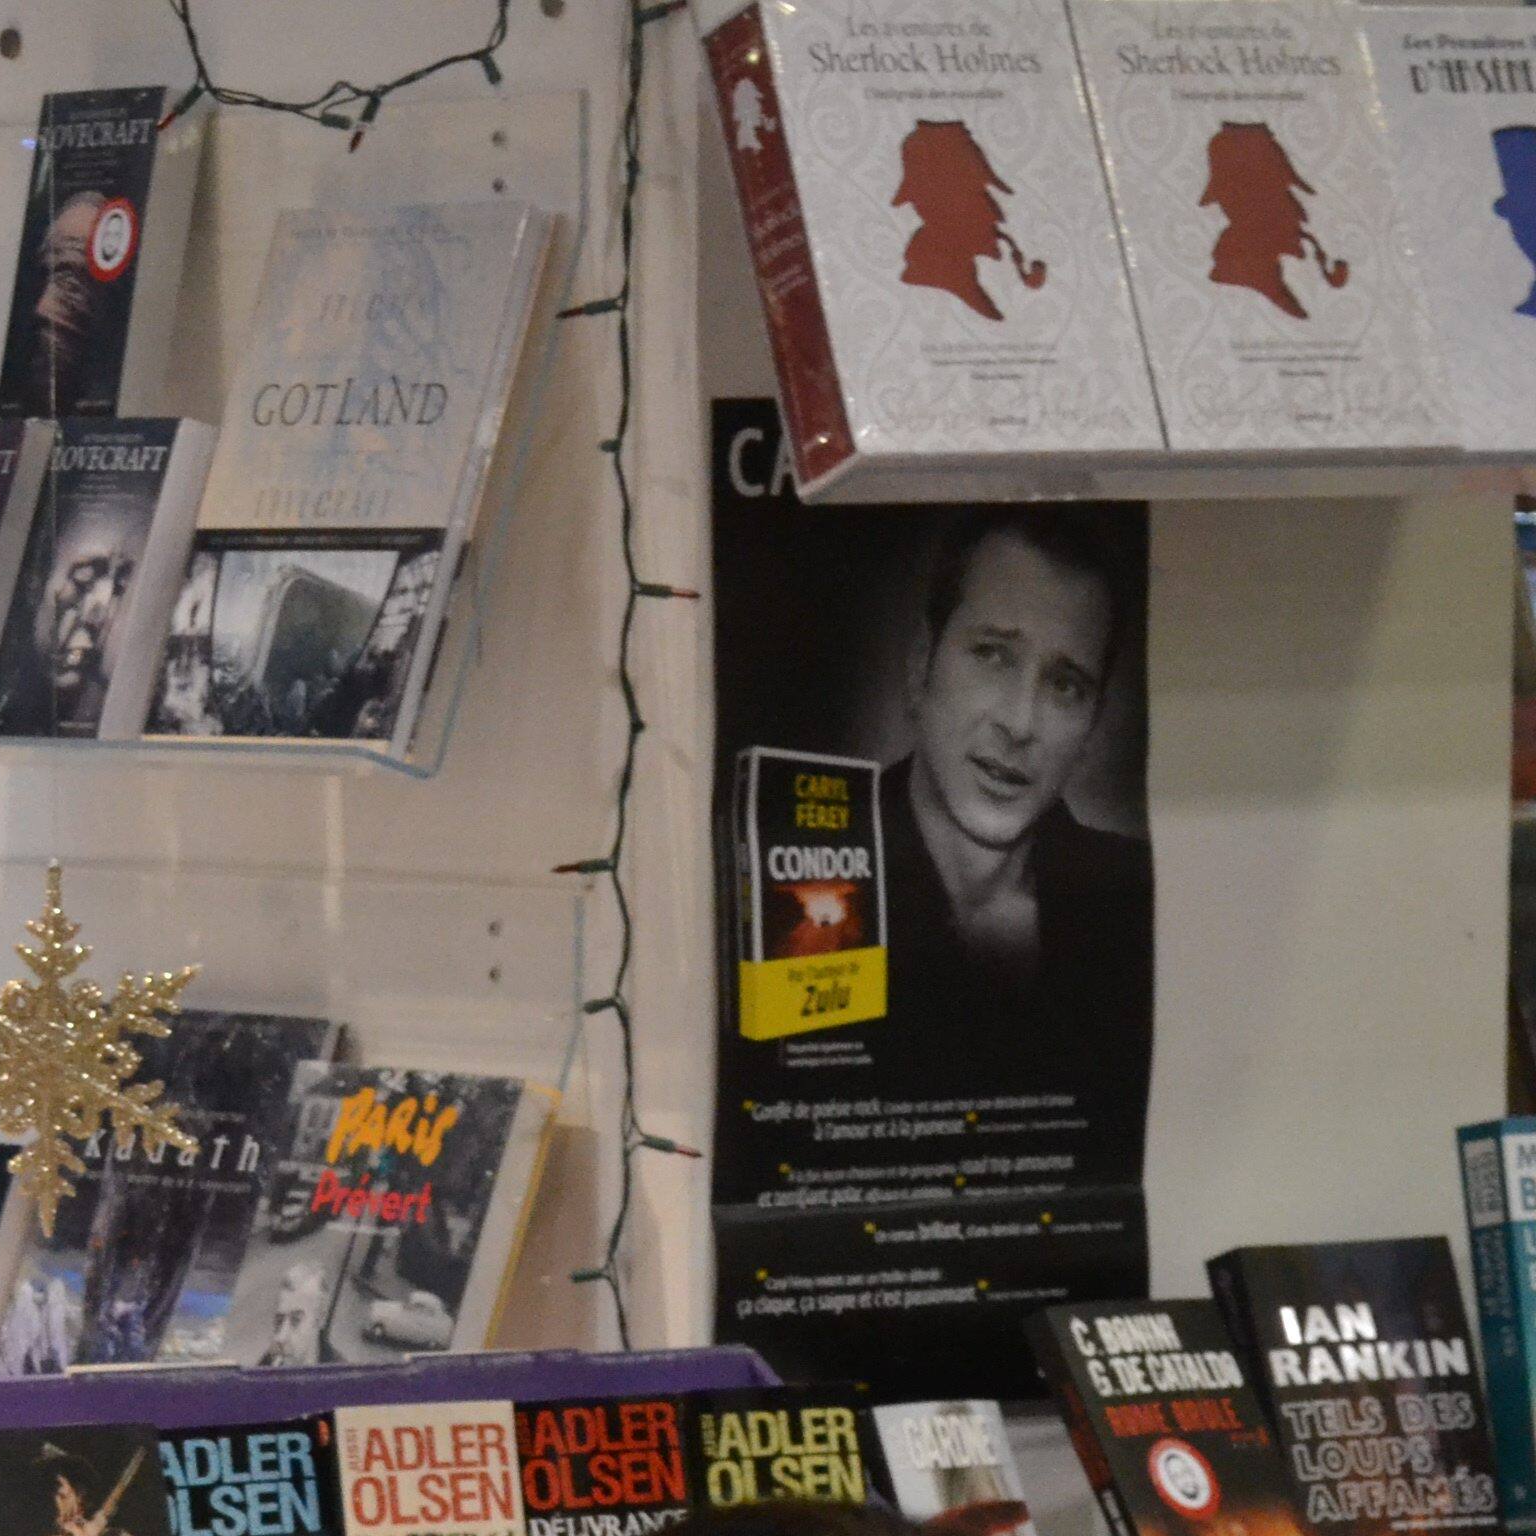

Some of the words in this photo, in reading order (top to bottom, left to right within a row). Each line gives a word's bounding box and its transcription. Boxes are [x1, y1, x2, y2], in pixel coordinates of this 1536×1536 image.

[809, 41, 927, 73] Sherlock
[933, 42, 1042, 73] Holmes
[1118, 44, 1231, 75] Sherlock
[1236, 45, 1342, 76] Holmes
[39, 117, 158, 150] LOVECRAFT
[252, 374, 448, 427] GOTLAND
[52, 446, 168, 472] LOVECRAFT
[768, 845, 872, 882] CONDOR
[311, 1169, 432, 1224] Prévert
[1279, 1302, 1378, 1346] IAN
[1267, 1337, 1471, 1388] RANKIN
[532, 1401, 681, 1457] ADLER
[718, 1406, 860, 1459] ADLER
[1281, 1396, 1385, 1441] TELS
[1396, 1393, 1477, 1433] DES
[158, 1431, 314, 1488] ADLER
[364, 1423, 510, 1472] ADLER
[1292, 1435, 1436, 1482] LOUPS
[352, 1470, 514, 1526] OLSEN
[522, 1451, 687, 1511] OLSEN
[707, 1453, 867, 1508] OLSEN
[1306, 1466, 1498, 1523] AFFAMÉS
